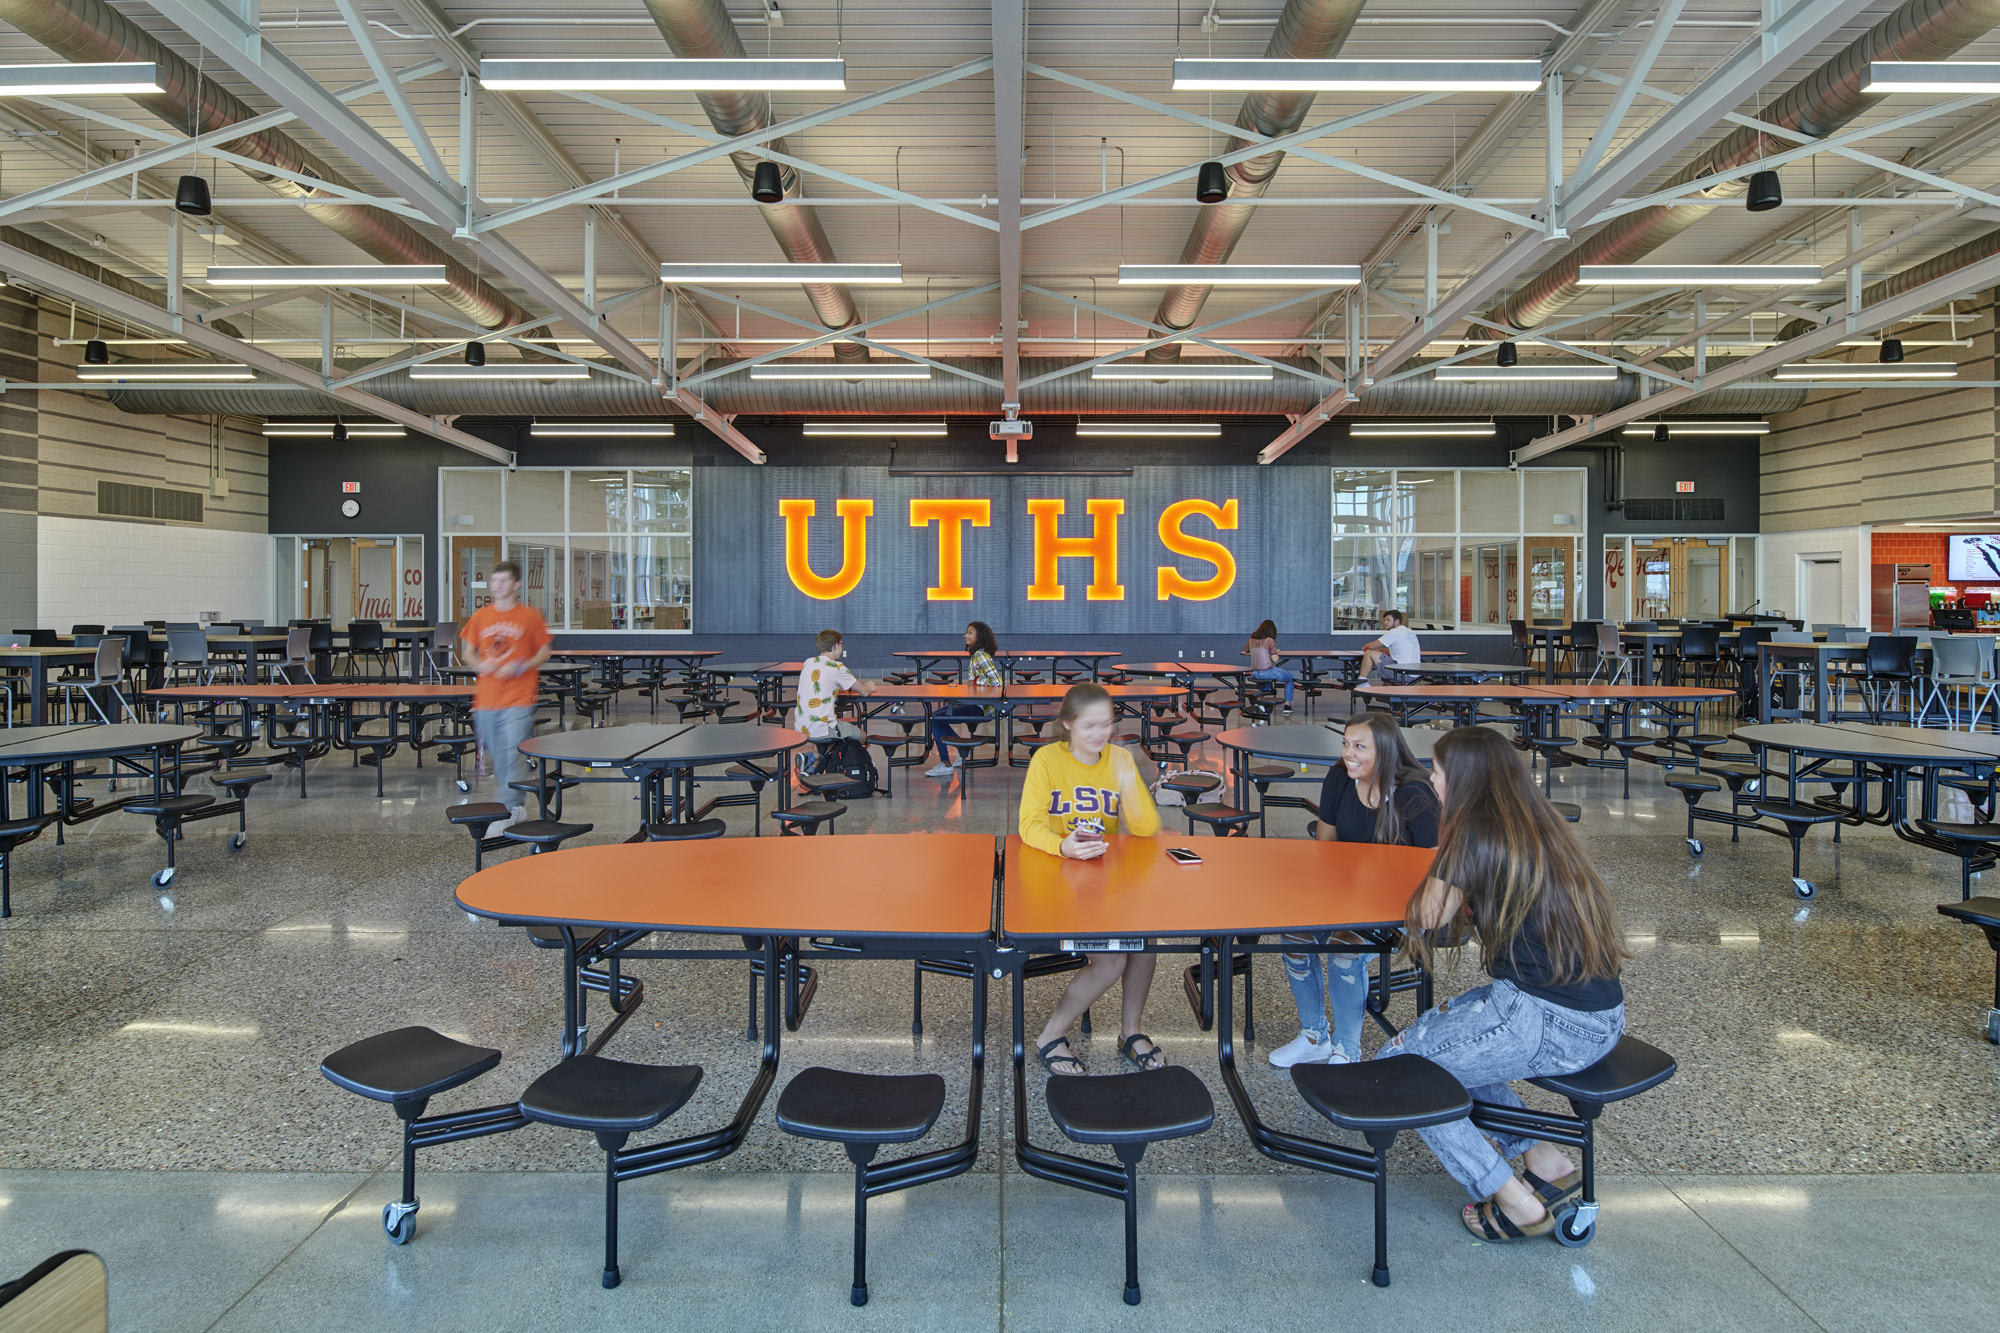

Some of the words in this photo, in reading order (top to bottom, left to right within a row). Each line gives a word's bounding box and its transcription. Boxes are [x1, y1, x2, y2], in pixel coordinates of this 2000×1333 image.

[345, 482, 357, 492] EXIT
[1680, 482, 1692, 491] EXIT
[778, 498, 1239, 601] UTHS
[1605, 546, 1667, 588] Repect
[360, 583, 422, 619] Imaine
[1048, 786, 1120, 816] LSU
